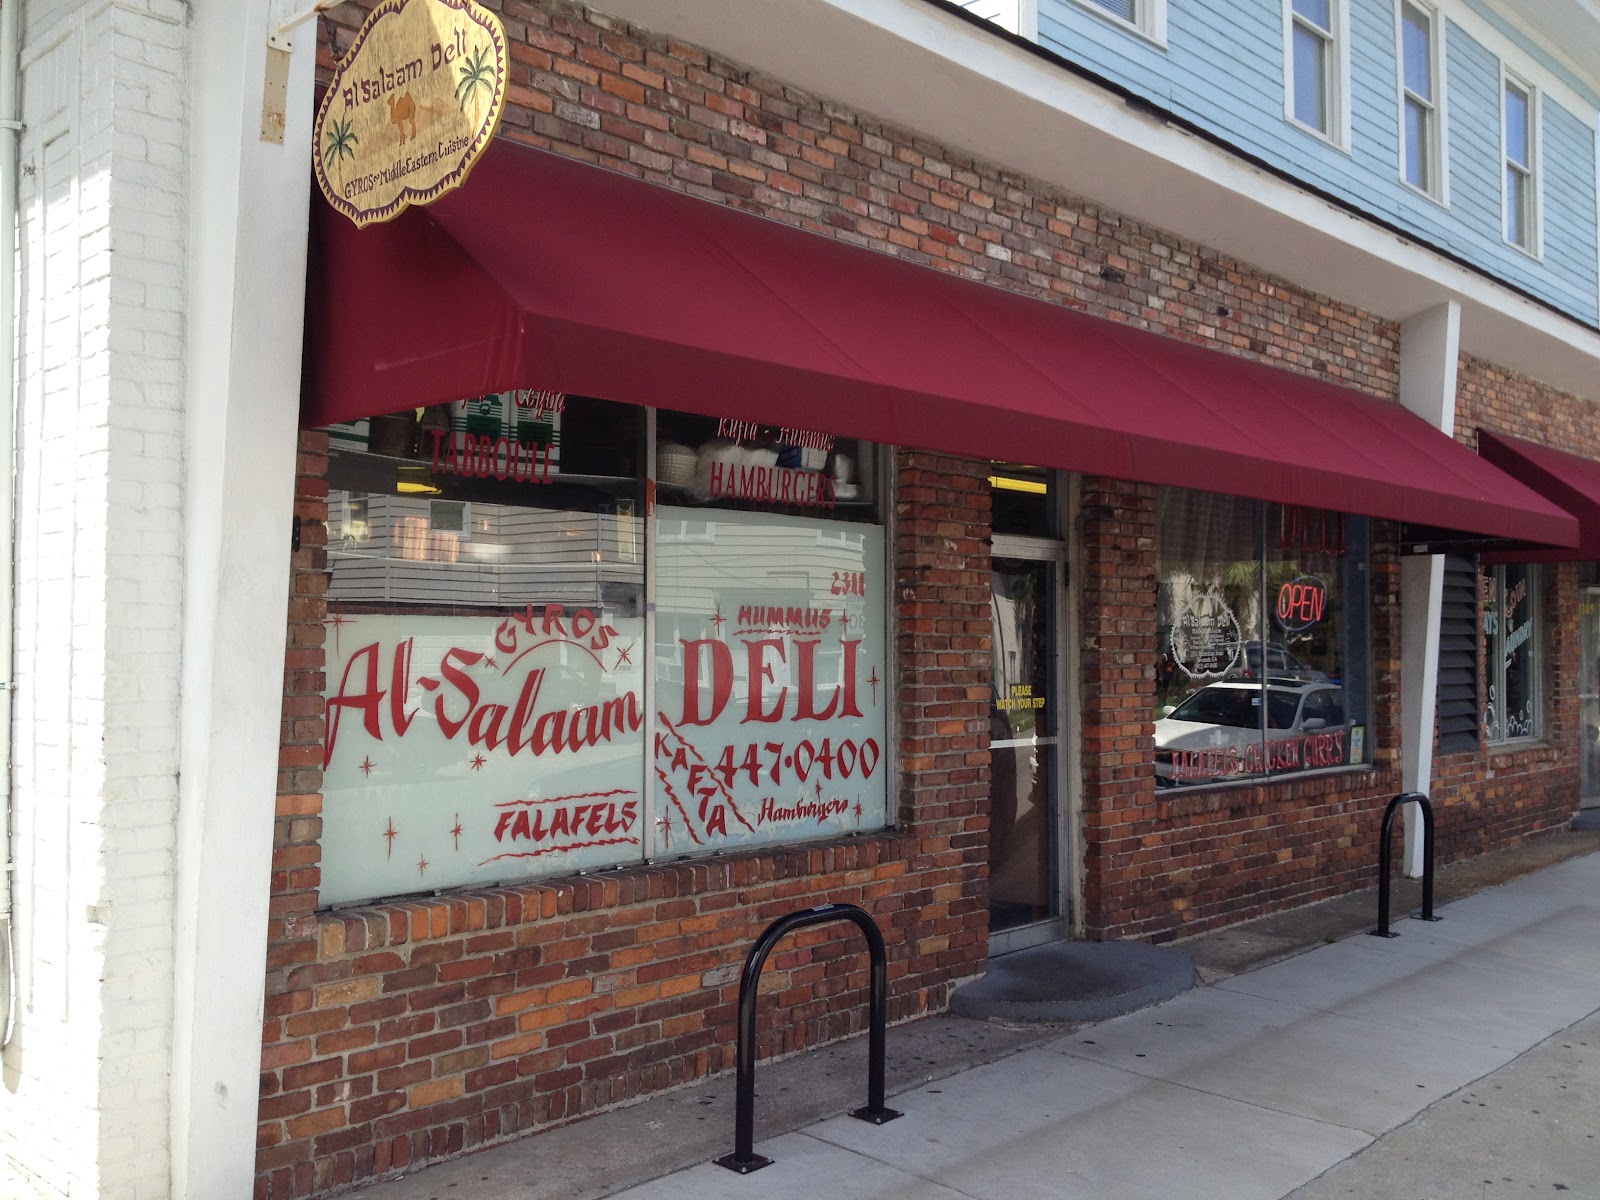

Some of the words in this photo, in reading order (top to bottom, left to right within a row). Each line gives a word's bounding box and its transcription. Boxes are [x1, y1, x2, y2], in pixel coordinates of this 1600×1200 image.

[431, 26, 467, 71] Deli
[438, 136, 469, 158] Cuisine
[431, 429, 555, 485] TABBOULE
[709, 461, 838, 509] HAMBURGERS
[831, 571, 865, 597] 2311
[1278, 583, 1325, 622] OPEN
[495, 603, 619, 654] GYROS
[738, 605, 832, 629] HUMMUS
[323, 637, 643, 771] Al-Salaam
[675, 637, 864, 728] DELI
[995, 699, 1016, 710] WATCH
[1018, 698, 1032, 709] YOUR
[1032, 697, 1046, 708] STEP
[1011, 685, 1032, 696] PLEASE
[1303, 730, 1345, 766] CURRY
[655, 733, 727, 837] KAFTA
[494, 800, 638, 843] FALAFELS
[757, 797, 848, 826] Hamburgers
